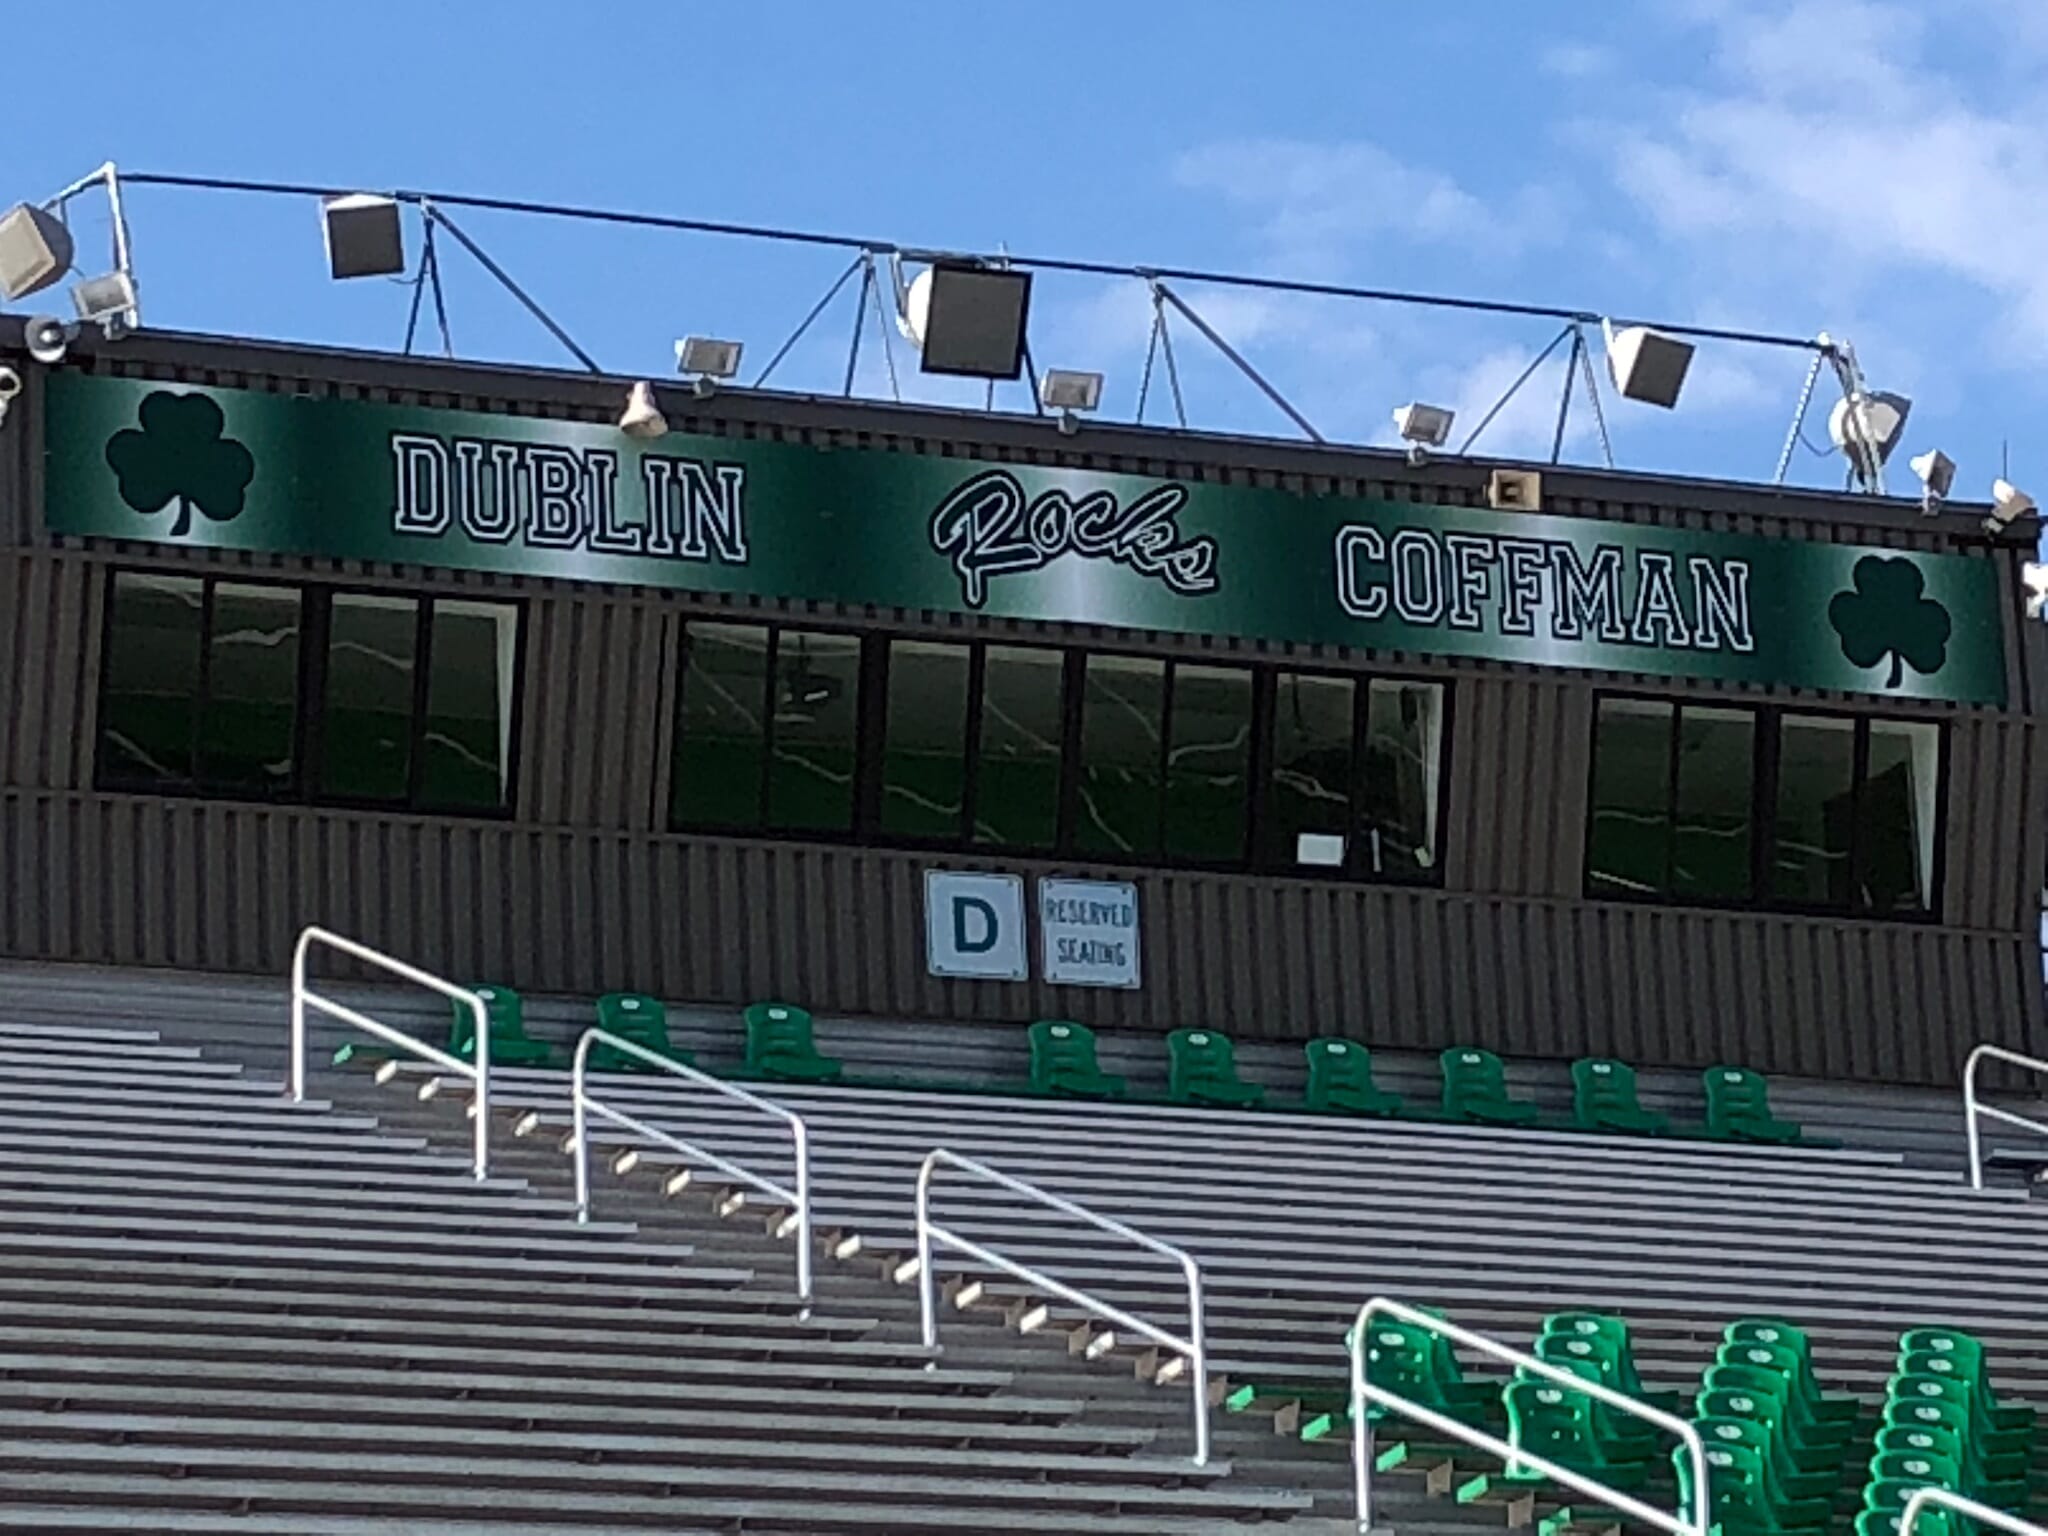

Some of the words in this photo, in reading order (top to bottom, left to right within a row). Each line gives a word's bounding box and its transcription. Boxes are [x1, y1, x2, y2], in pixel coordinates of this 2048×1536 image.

[391, 433, 748, 564] DUBLIN
[930, 471, 1219, 607] Rocks
[1333, 523, 1755, 653] COFFMAN
[953, 896, 998, 952] D
[1046, 899, 1133, 928] RESERVED
[1057, 937, 1126, 966] SEATING
